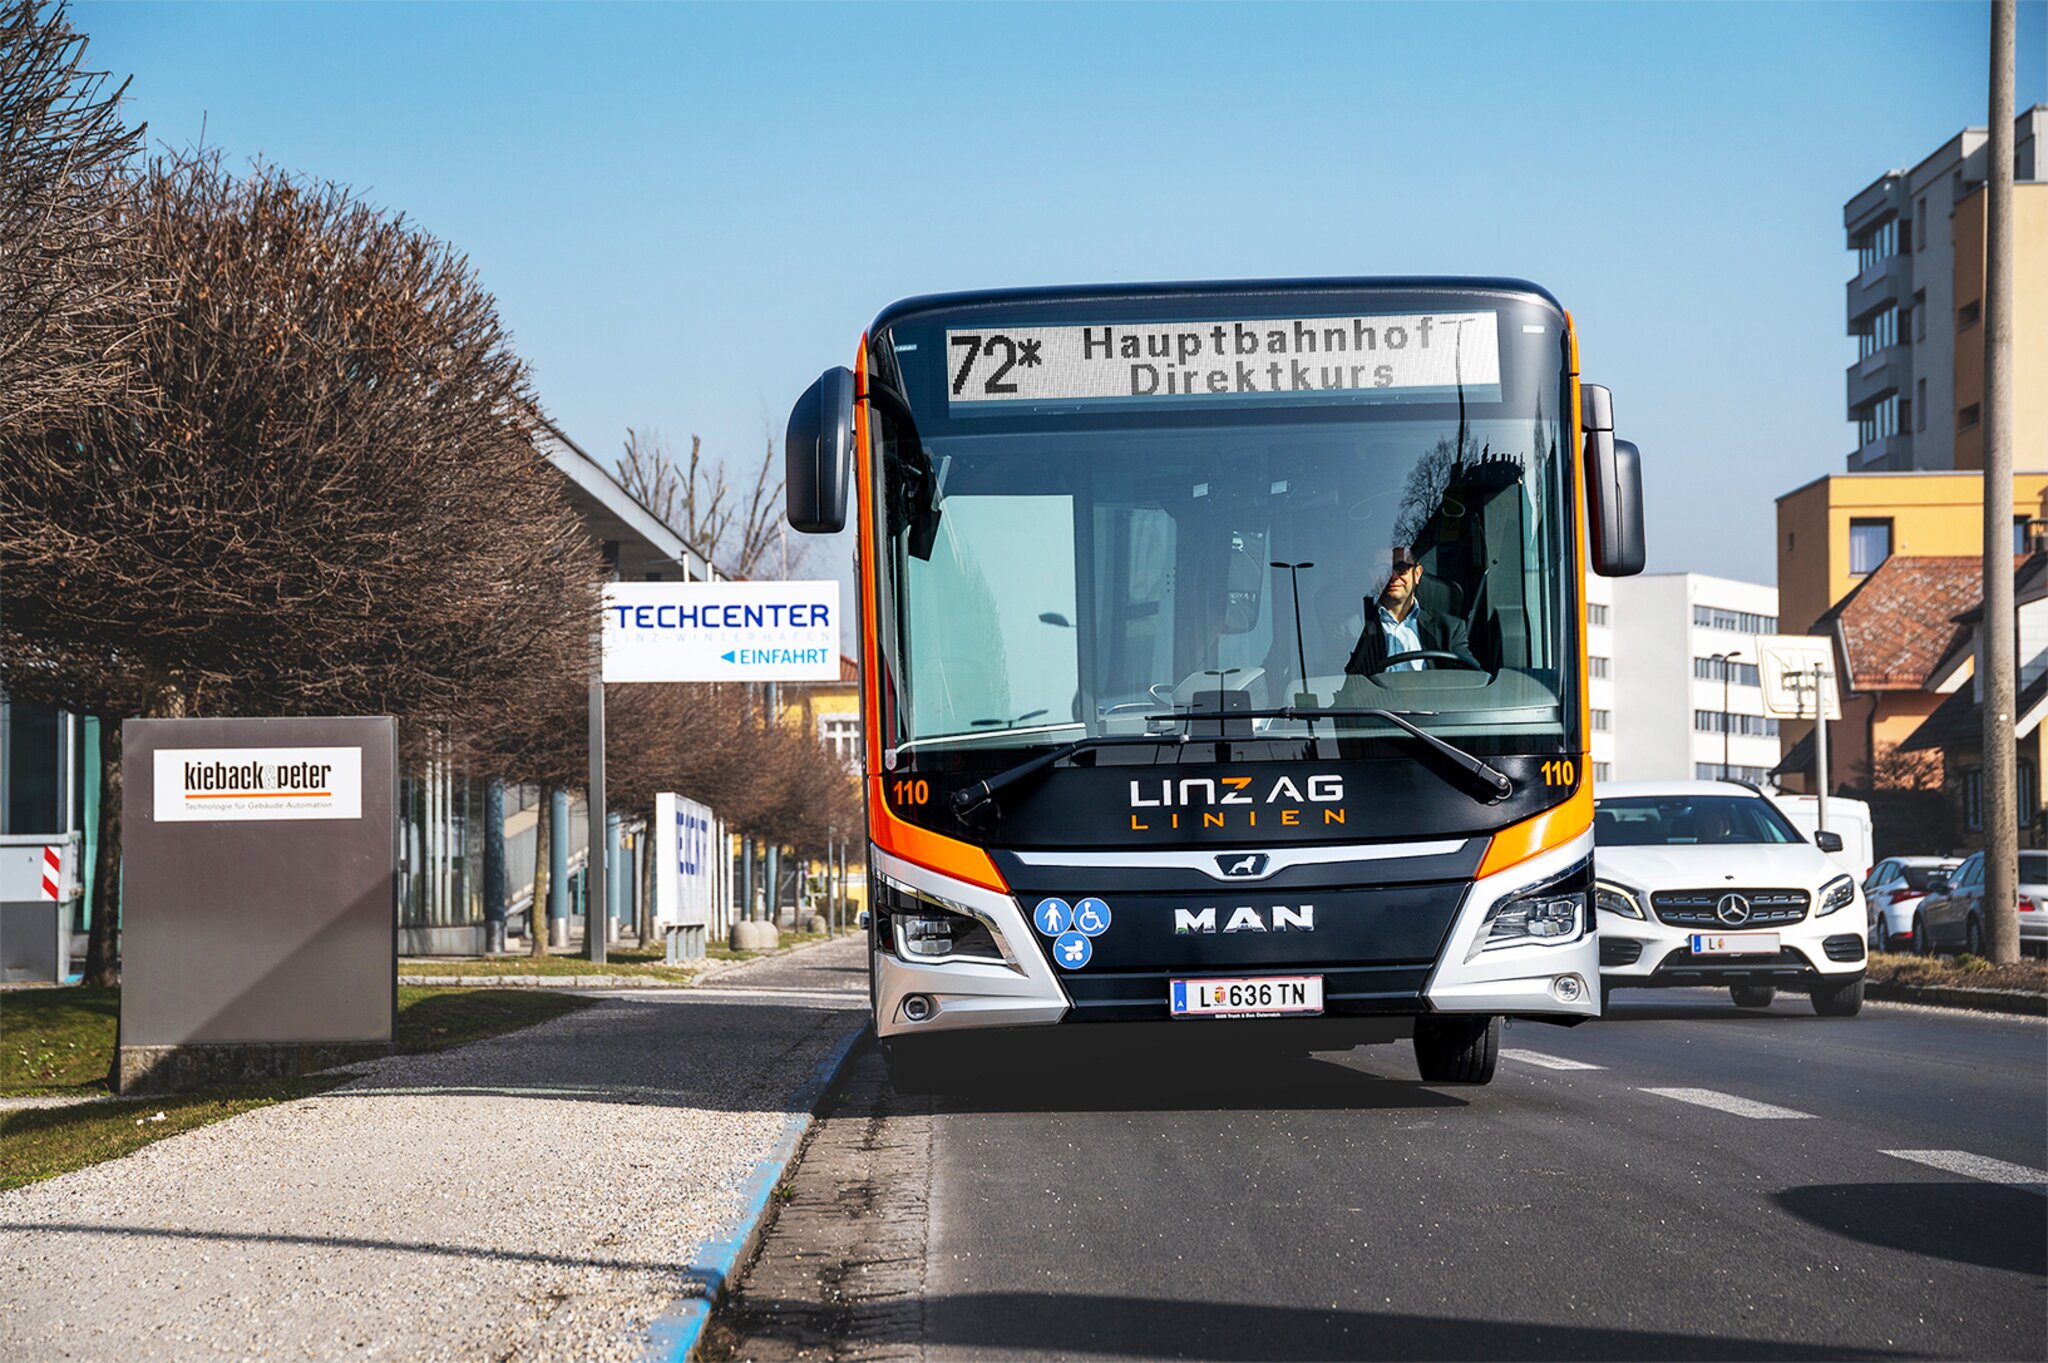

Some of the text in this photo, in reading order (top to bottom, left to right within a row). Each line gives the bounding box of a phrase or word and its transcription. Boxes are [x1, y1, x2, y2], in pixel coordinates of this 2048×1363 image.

[1084, 317, 1433, 364] Hauptbahnhof
[1130, 360, 1394, 396] Direktkurs
[614, 604, 829, 628] TECHCENTER
[740, 648, 829, 664] EINFAHRT
[1541, 760, 1574, 786] 110
[893, 779, 929, 805] 110
[1130, 774, 1344, 807] LINZ AG
[185, 802, 233, 811] Technologie
[234, 802, 246, 810] für
[1131, 808, 1346, 830] LINIEN
[1174, 904, 1315, 935] MAN
[1229, 984, 1272, 1007] 636
[1278, 983, 1305, 1005] TN
